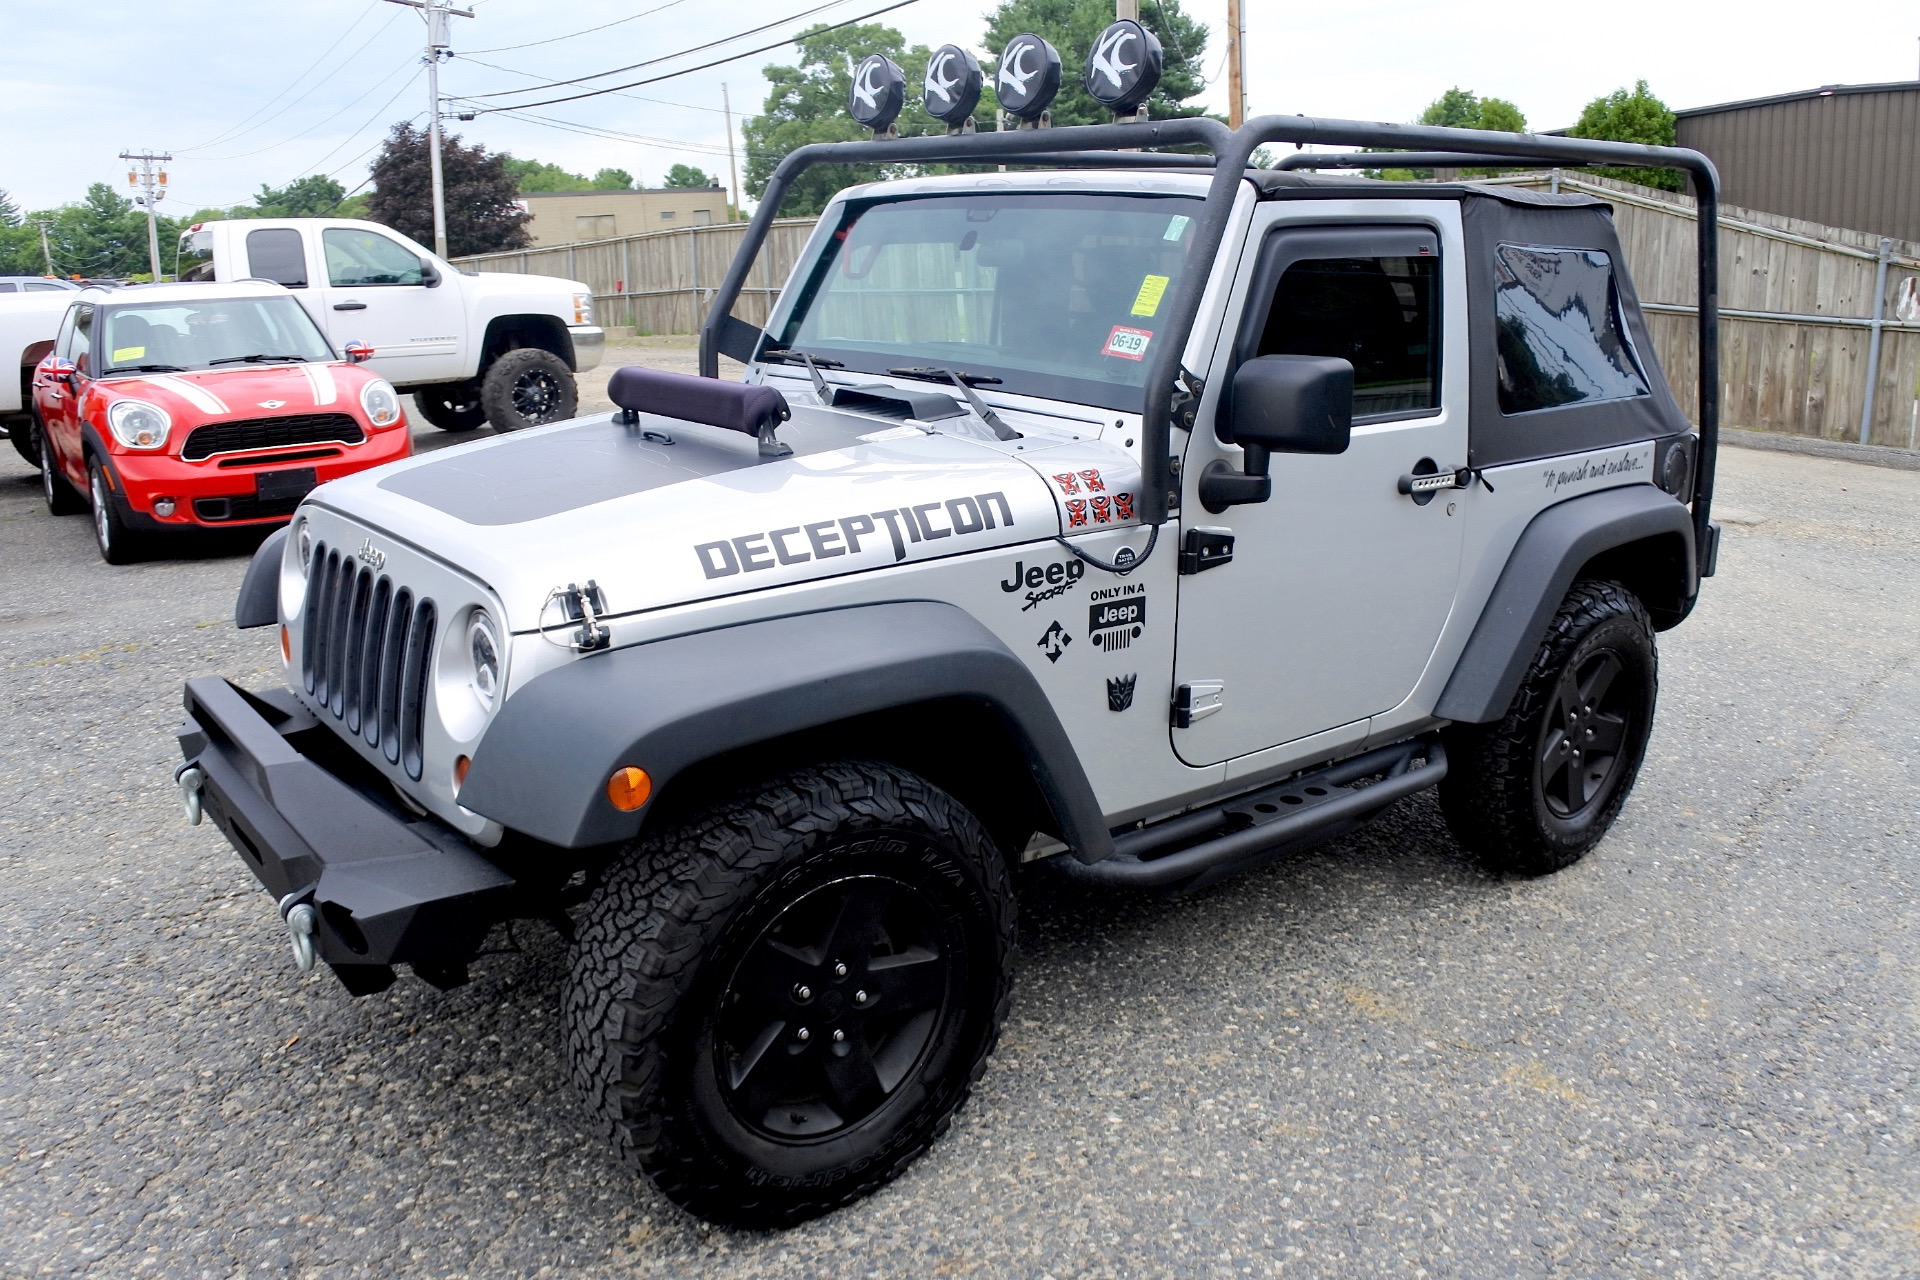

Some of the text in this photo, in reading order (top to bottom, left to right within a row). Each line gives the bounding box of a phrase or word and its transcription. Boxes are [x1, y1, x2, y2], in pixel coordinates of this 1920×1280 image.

[998, 42, 1038, 97] KC
[1091, 28, 1137, 89] KC
[852, 60, 884, 110] KC
[924, 51, 959, 104] KC
[1111, 333, 1142, 351] 06-19
[1554, 460, 1589, 493] punish
[1589, 458, 1608, 479] and
[693, 491, 1015, 580] DECEPTICON
[358, 537, 386, 573] Jeep
[1001, 559, 1084, 593] Jeep
[1090, 583, 1145, 601] ONLY IN A
[1098, 604, 1138, 624] Jeep
